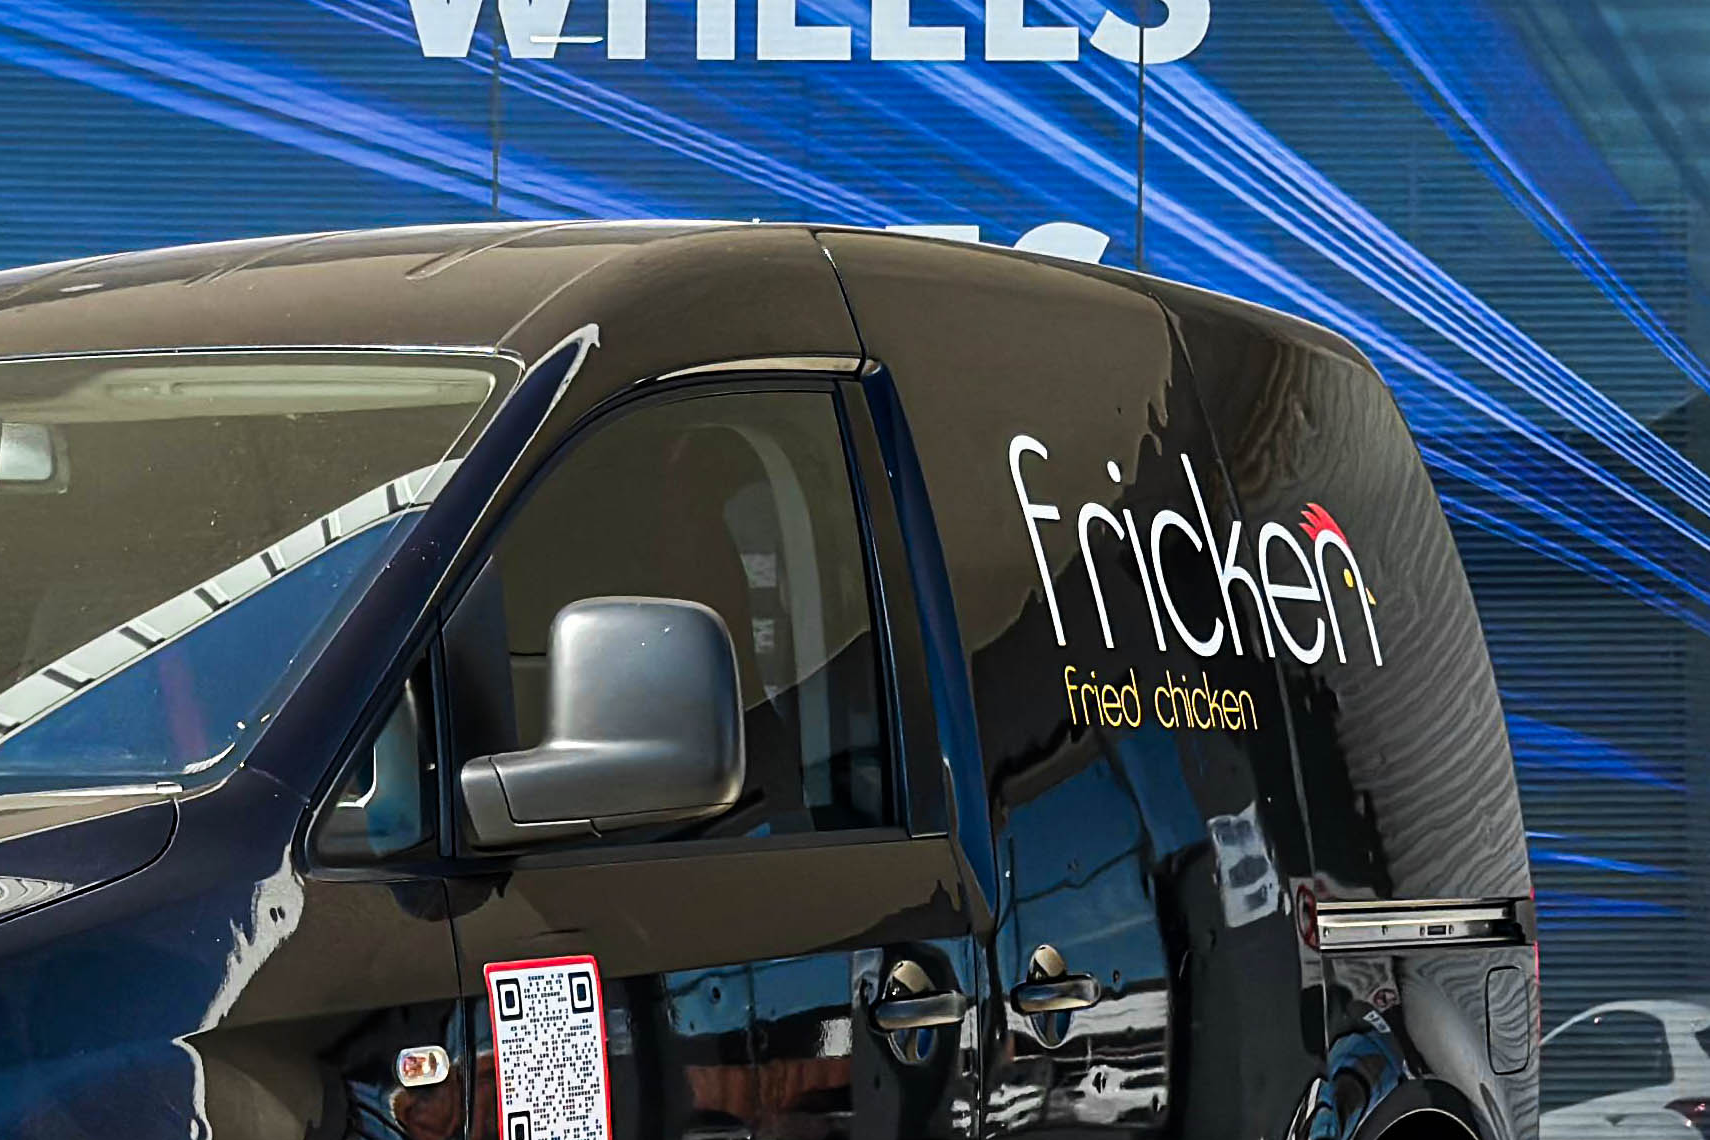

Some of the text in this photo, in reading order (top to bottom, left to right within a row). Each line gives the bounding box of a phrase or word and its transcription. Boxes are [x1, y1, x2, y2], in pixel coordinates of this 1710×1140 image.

[1009, 435, 1383, 667] fricken
[1064, 666, 1258, 731] fried chicken
